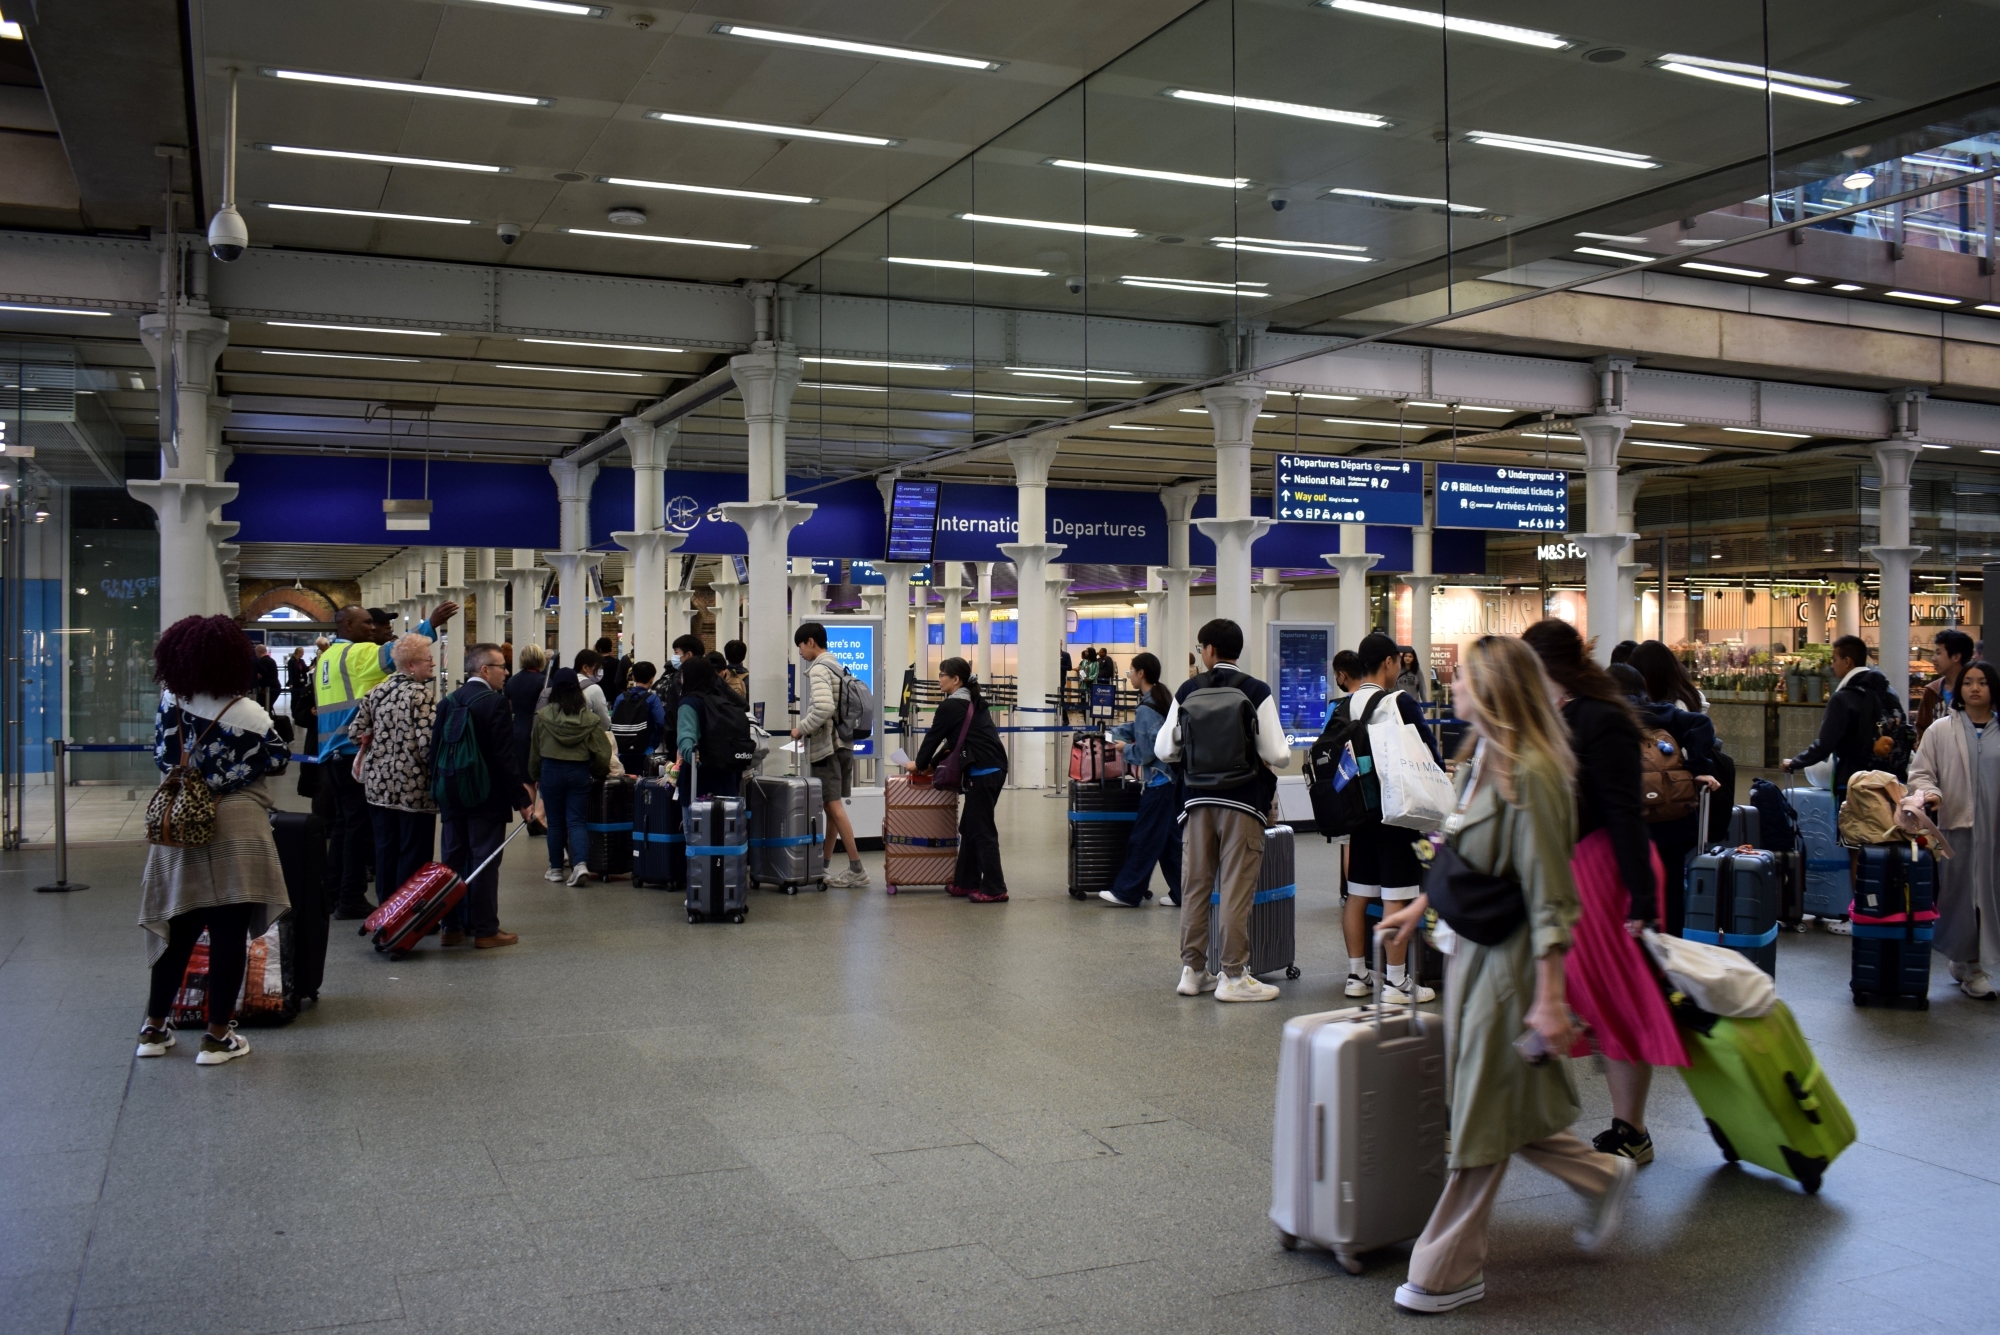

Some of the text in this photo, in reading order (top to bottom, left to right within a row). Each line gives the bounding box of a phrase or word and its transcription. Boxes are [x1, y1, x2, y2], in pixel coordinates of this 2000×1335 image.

[1293, 457, 1340, 469] Departures
[1341, 460, 1372, 471] Départs
[1294, 474, 1346, 486] National Rail
[1508, 469, 1554, 482] Underground
[1459, 482, 1554, 497] Billets International tickets
[1294, 491, 1327, 503] Way out
[1495, 501, 1526, 511] Arrivées
[1526, 502, 1555, 512] Arrivals
[1053, 518, 1147, 539] Departures
[1537, 543, 1566, 561] M&S
[1454, 598, 1532, 634] PANCRAS
[855, 652, 865, 660] so
[734, 752, 753, 760] adida
